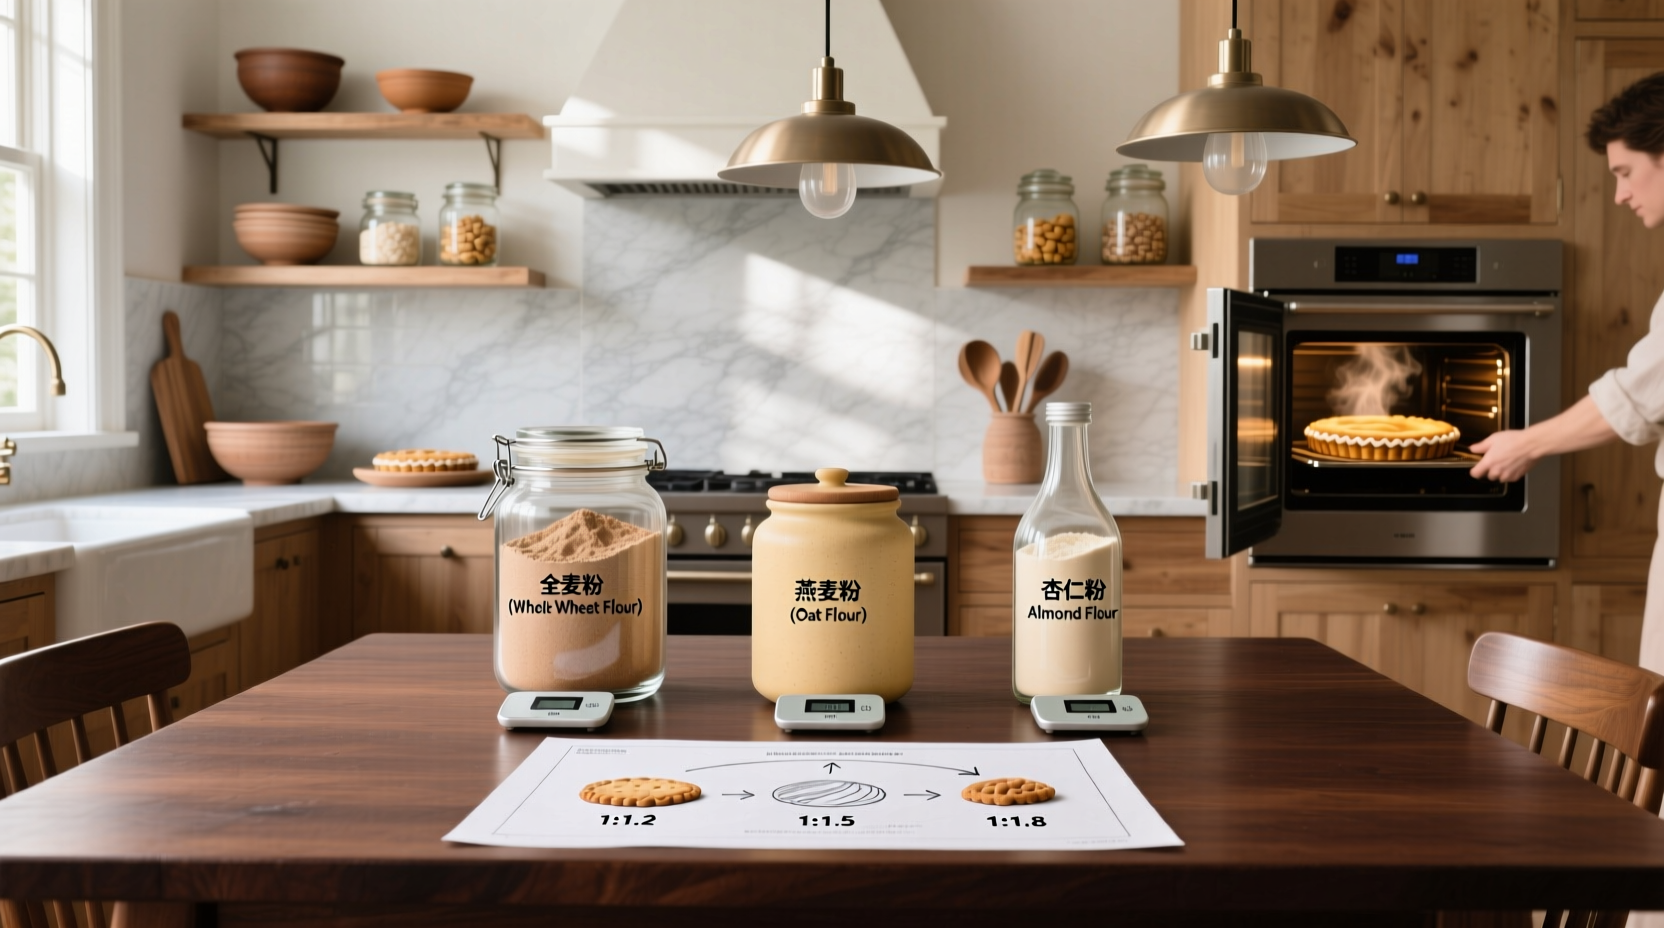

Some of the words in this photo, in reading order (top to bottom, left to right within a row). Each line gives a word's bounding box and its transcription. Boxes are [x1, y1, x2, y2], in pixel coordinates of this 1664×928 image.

[540, 573, 604, 596] 全麦粉
[795, 578, 861, 602] 燕麦粉
[1041, 578, 1106, 601] 杏仁粉
[603, 598, 643, 616] Flour)
[790, 606, 822, 624] (Oat
[825, 606, 867, 624] Flour)
[1027, 604, 1082, 621] Almond
[1085, 605, 1119, 620] Flour
[600, 814, 657, 826] 1:1.2
[799, 815, 855, 827] 1:1.5
[986, 815, 1047, 827] 1:1.8
